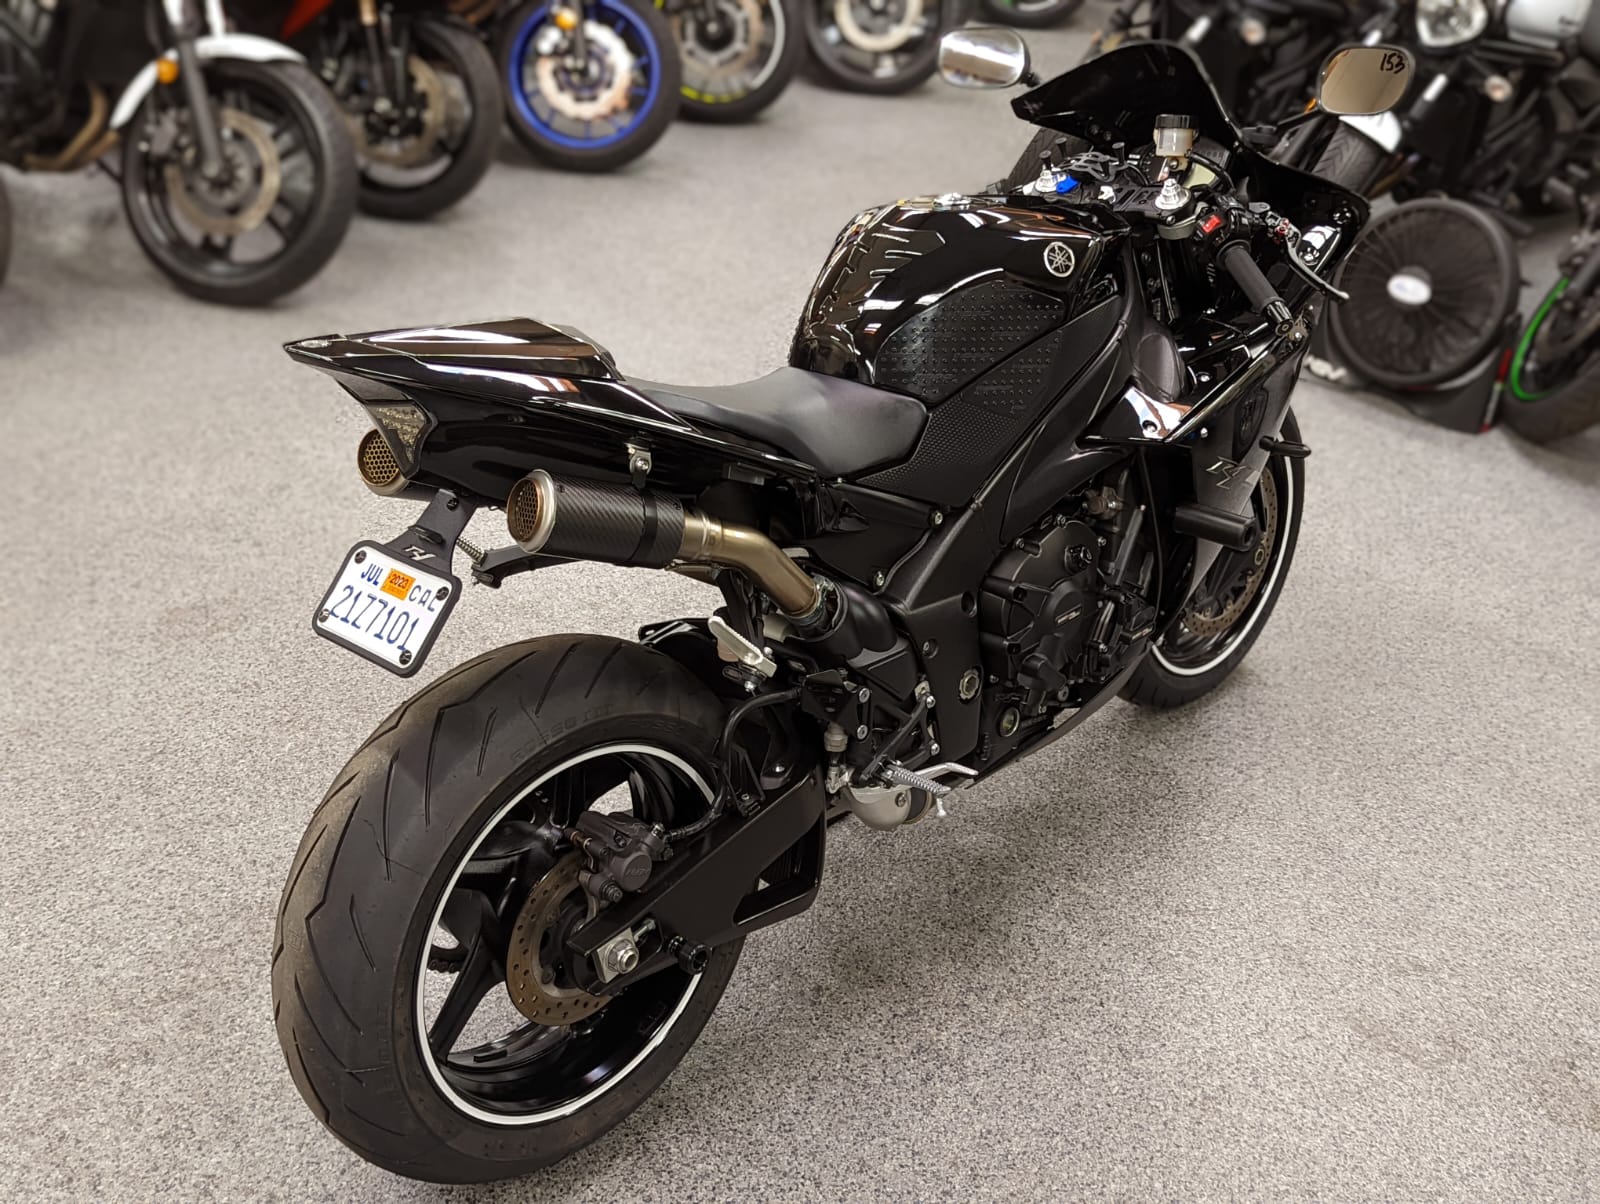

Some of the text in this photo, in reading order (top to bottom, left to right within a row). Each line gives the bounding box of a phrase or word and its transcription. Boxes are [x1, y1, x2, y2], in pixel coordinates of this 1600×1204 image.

[1380, 53, 1405, 74] 153
[361, 563, 383, 586] JUL
[390, 573, 409, 589] 2023
[329, 584, 420, 651] 21Z7101
